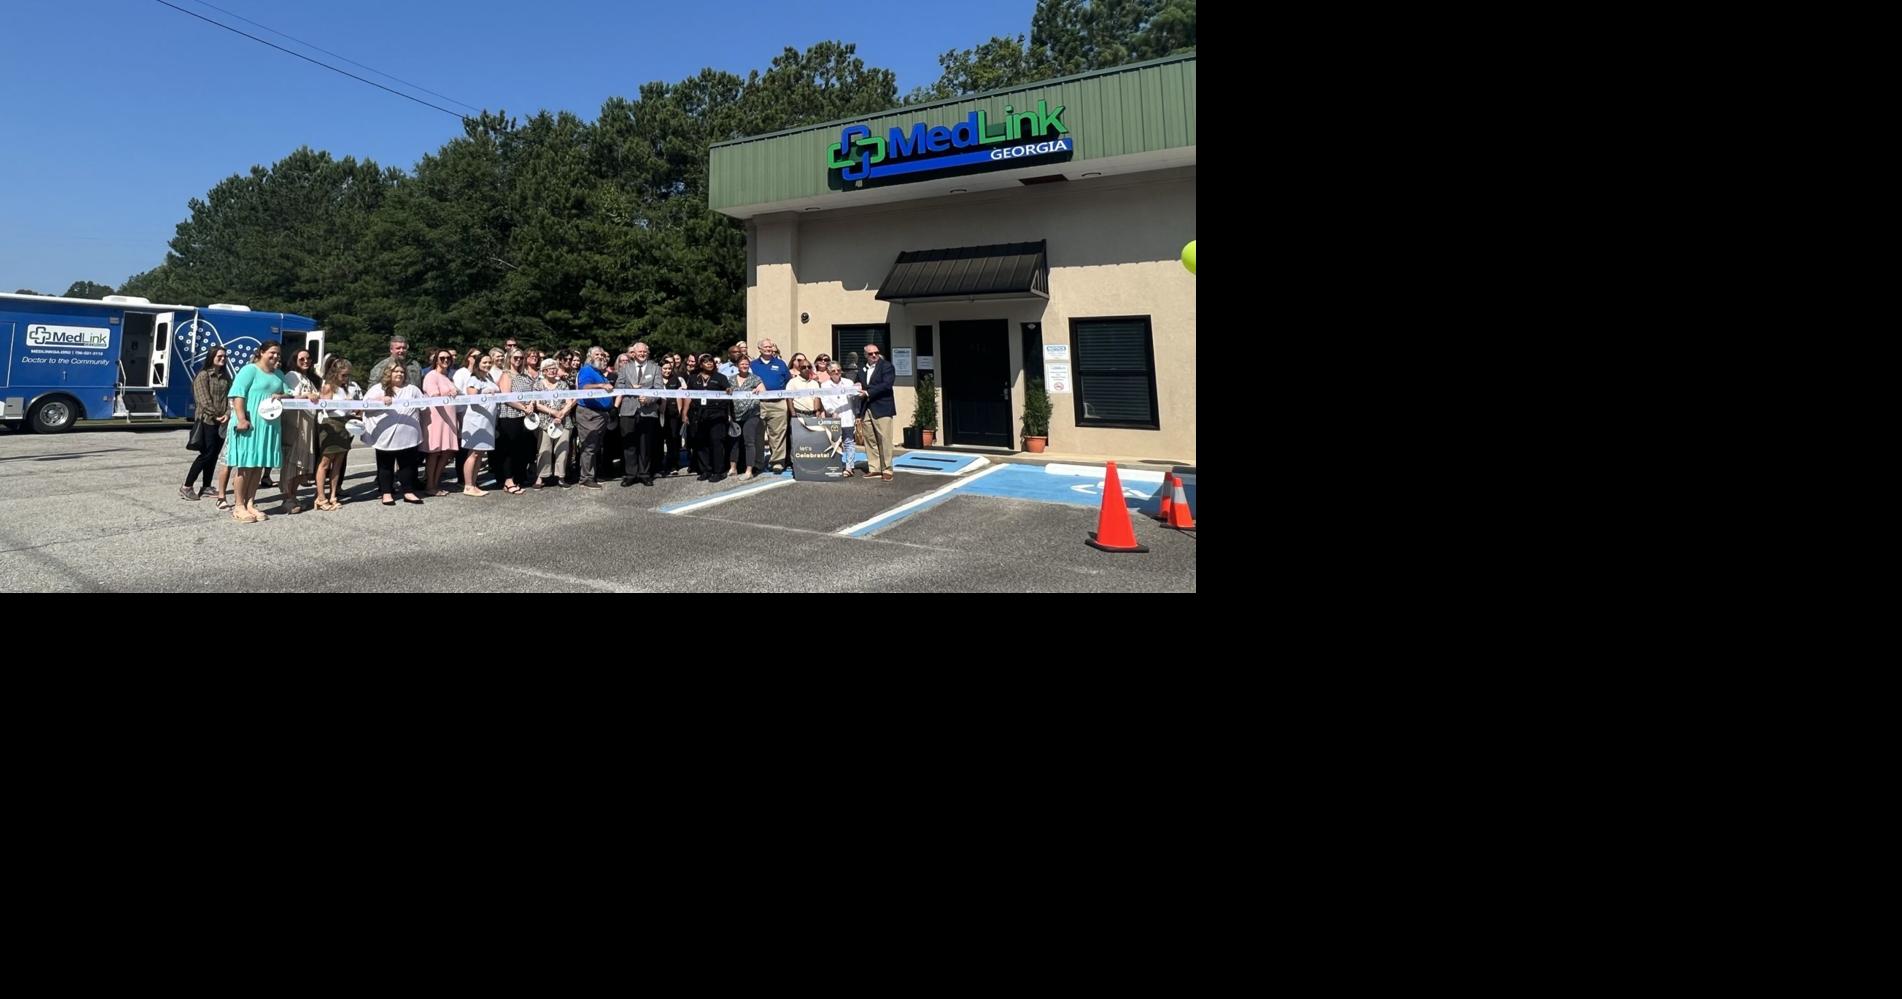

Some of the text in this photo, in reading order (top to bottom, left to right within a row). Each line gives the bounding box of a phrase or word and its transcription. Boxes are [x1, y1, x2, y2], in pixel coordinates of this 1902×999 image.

[888, 100, 1069, 158] MedLink
[990, 140, 1068, 160] GEORGIA
[52, 332, 107, 343] MedLink
[71, 358, 110, 366] Community
